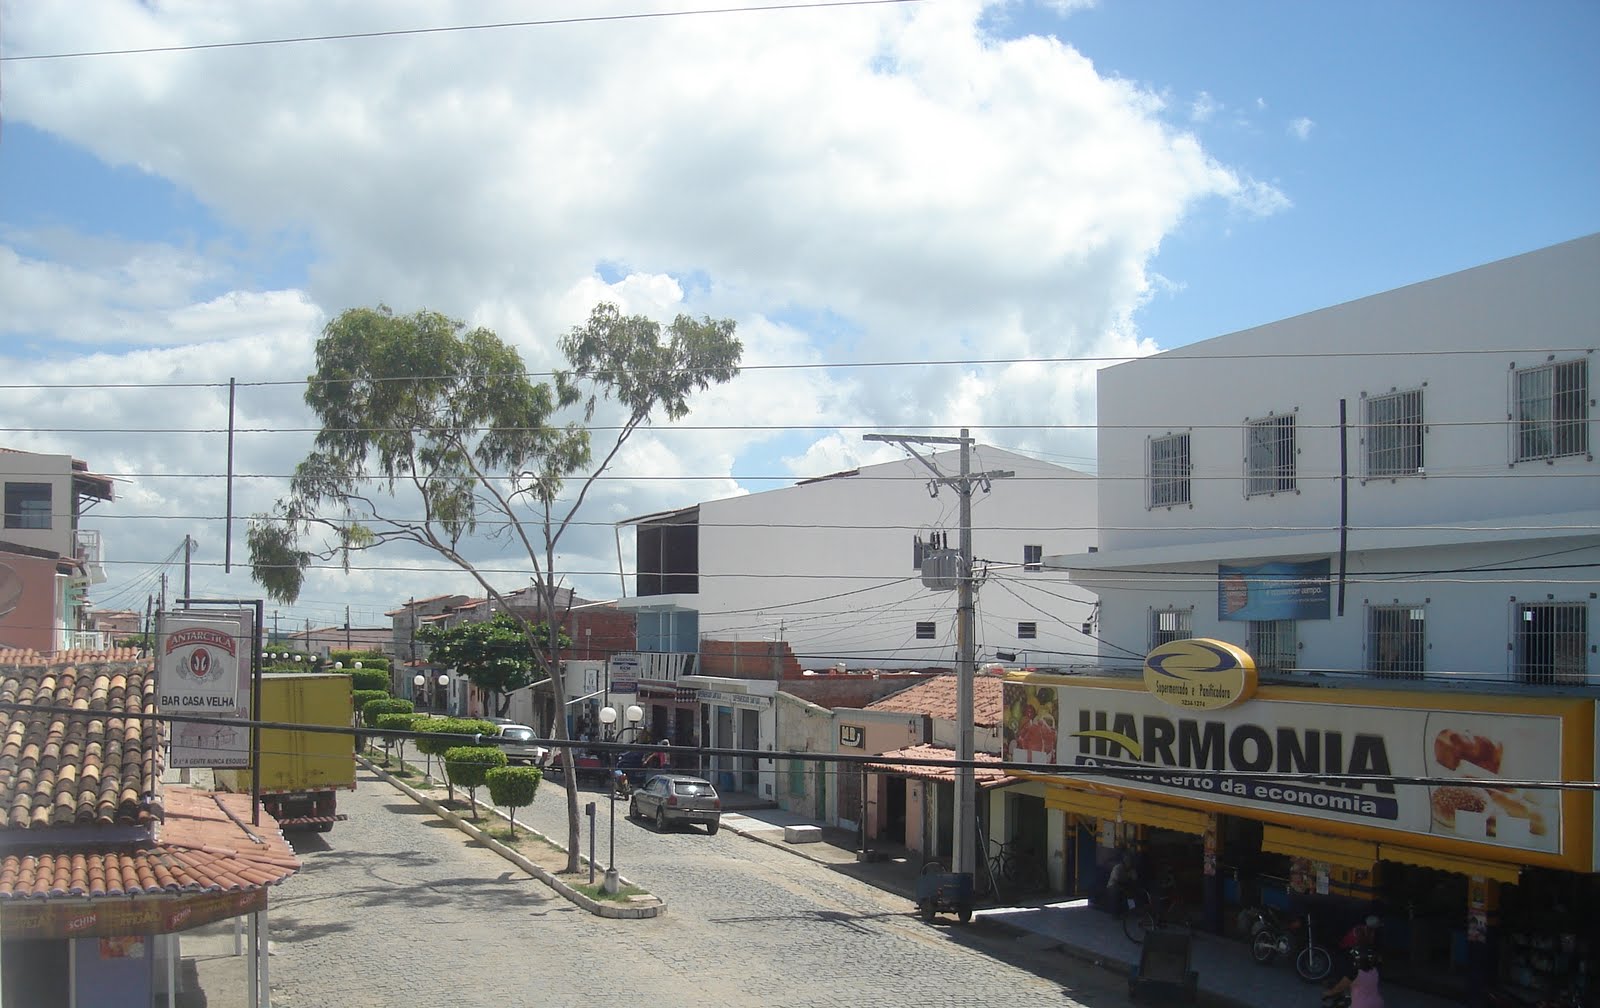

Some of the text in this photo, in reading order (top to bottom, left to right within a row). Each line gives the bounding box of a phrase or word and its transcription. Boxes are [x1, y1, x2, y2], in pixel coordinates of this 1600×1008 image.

[171, 631, 232, 648] ANTARCTICA
[1156, 681, 1188, 696] Supermercado
[1200, 683, 1231, 698] Panificadora
[161, 696, 235, 707] BAR CASA VELHA
[1079, 710, 1396, 794] HARMONIA
[1221, 778, 1247, 796] da
[1254, 784, 1377, 815] economia
[68, 914, 97, 929] SCHIN
